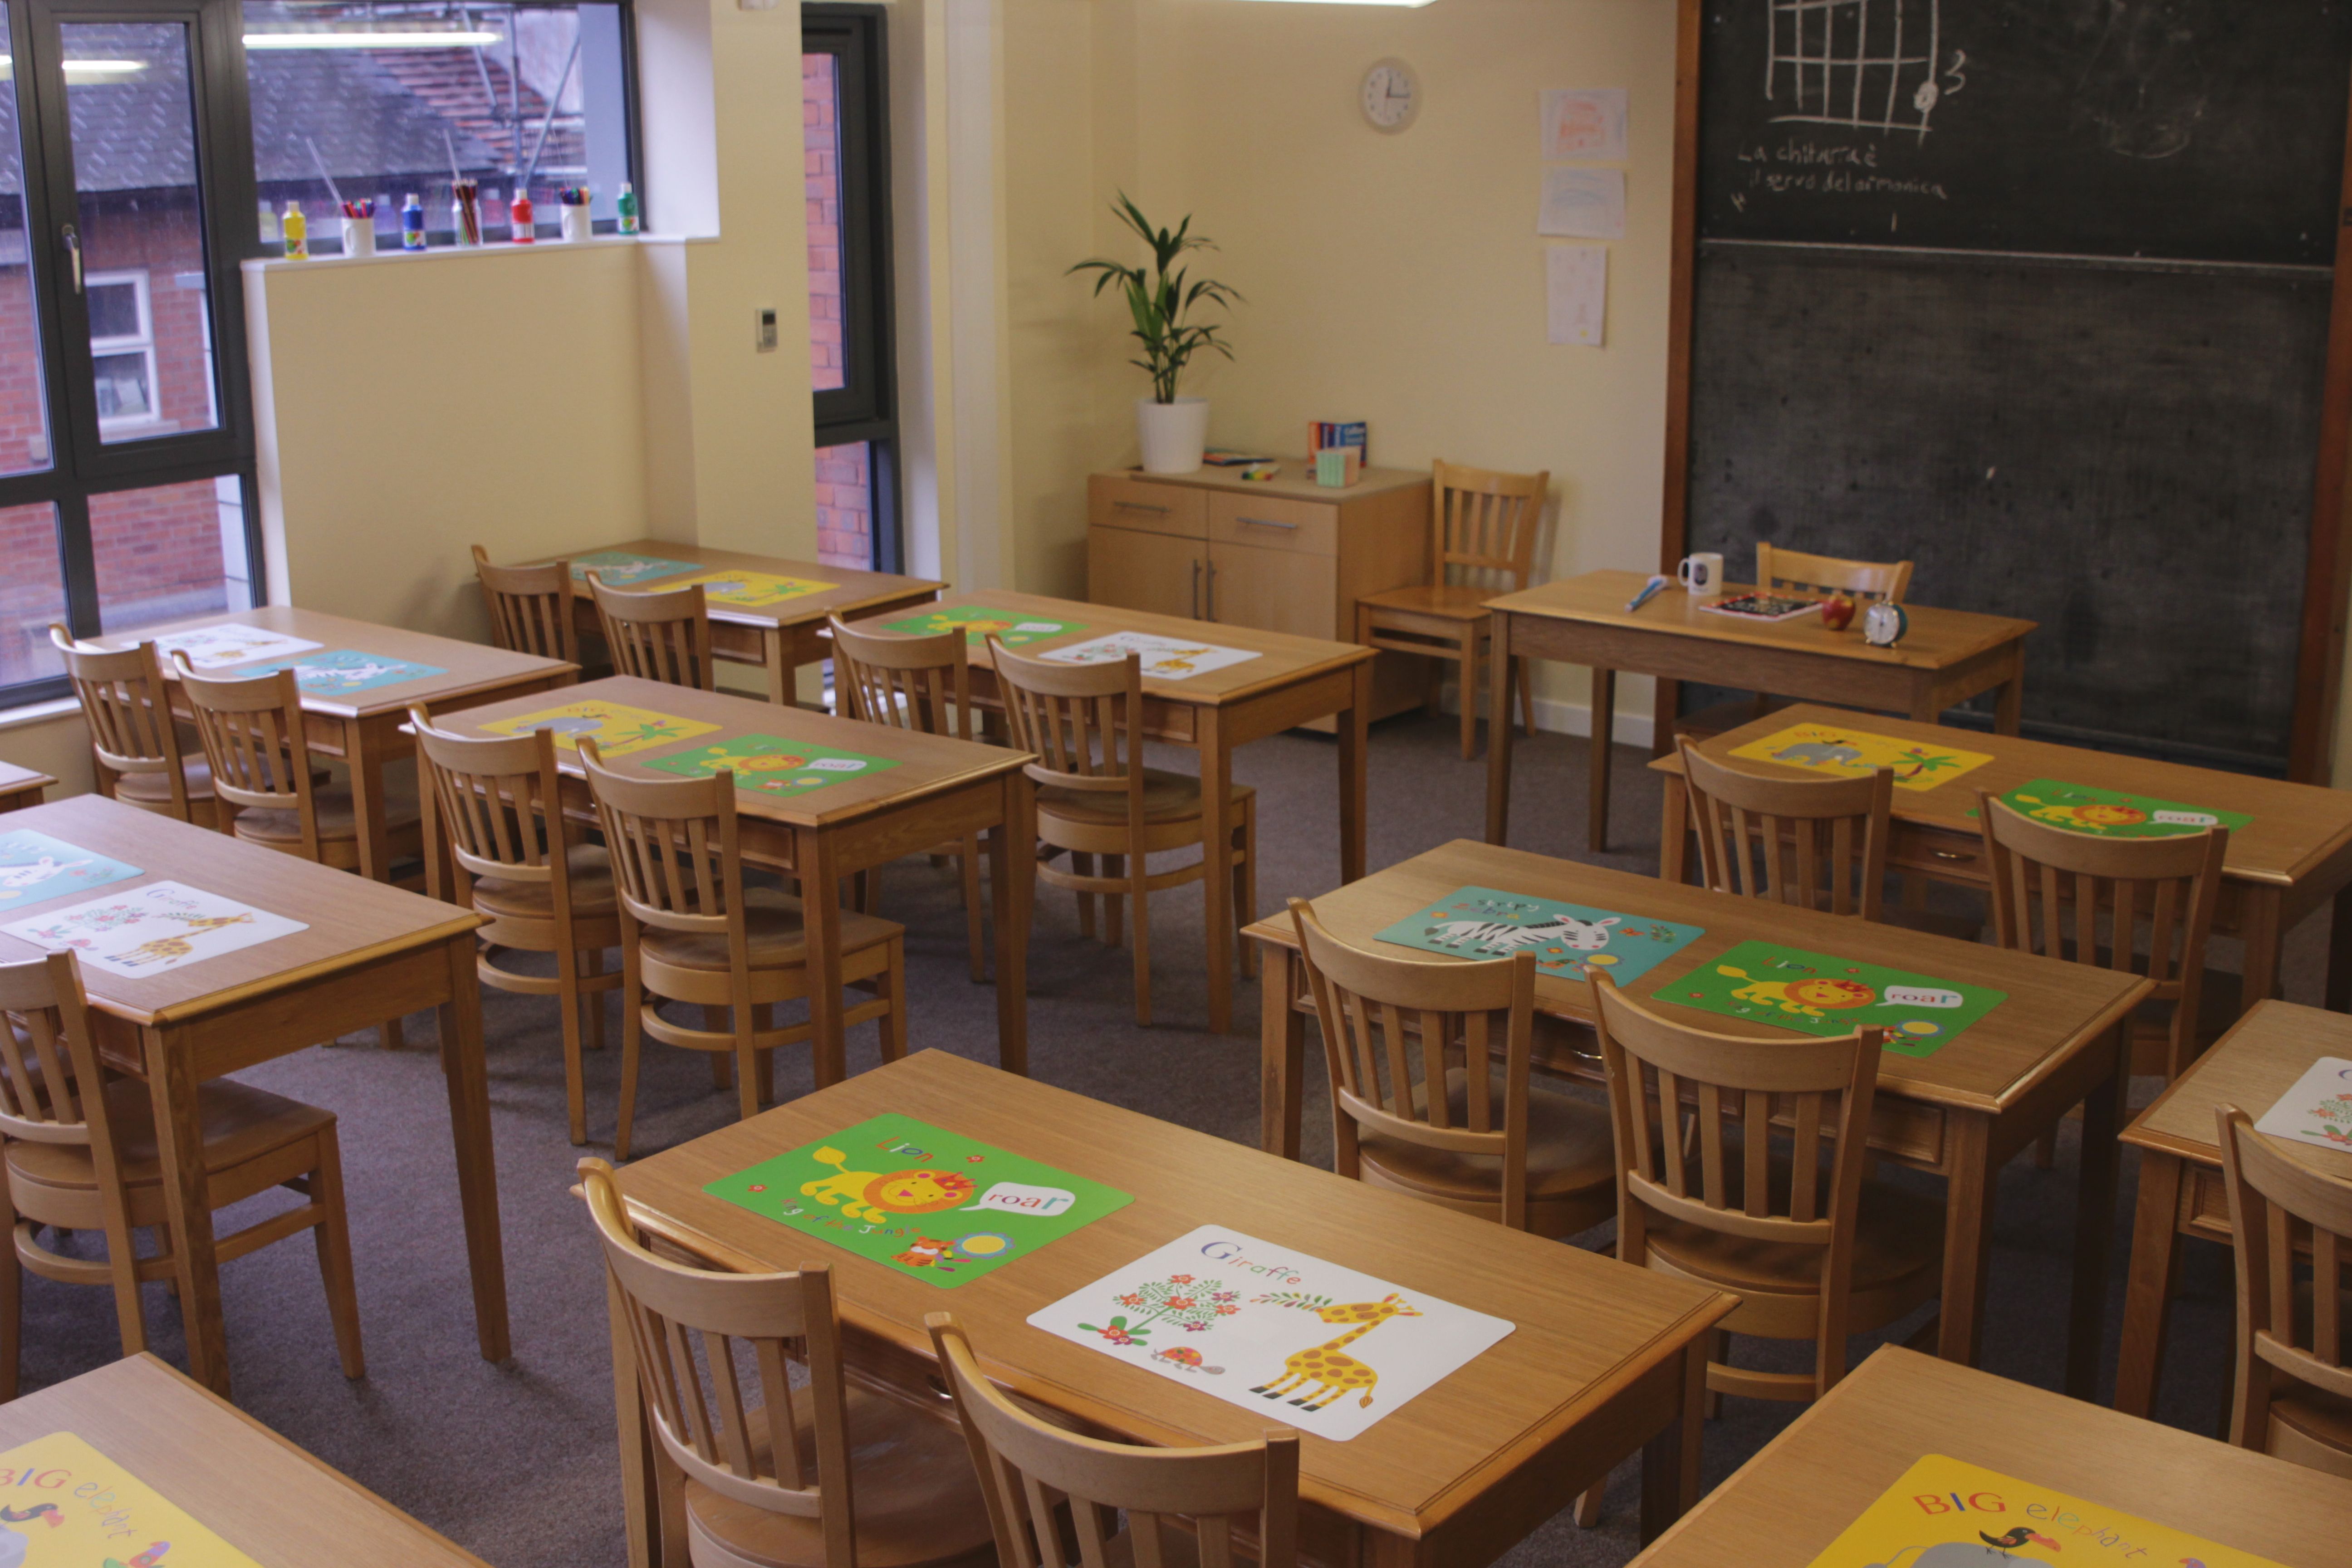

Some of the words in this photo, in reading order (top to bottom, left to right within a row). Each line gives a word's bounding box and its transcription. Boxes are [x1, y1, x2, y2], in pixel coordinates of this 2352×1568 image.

[1945, 49, 1966, 95] 3
[1738, 140, 1768, 162] La
[1761, 956, 1818, 975] Lion
[1891, 994, 1958, 1004] roar
[875, 1136, 934, 1163] Lion
[780, 1197, 804, 1215] King
[803, 1214, 830, 1223] of
[824, 1219, 853, 1231] the
[858, 1225, 921, 1238] Jungle
[988, 1194, 1069, 1210] roar
[1201, 1241, 1301, 1284] Giraffe
[74, 1482, 138, 1539] elephant
[1912, 1492, 2007, 1515] BIG
[2026, 1502, 2148, 1559] elephant
